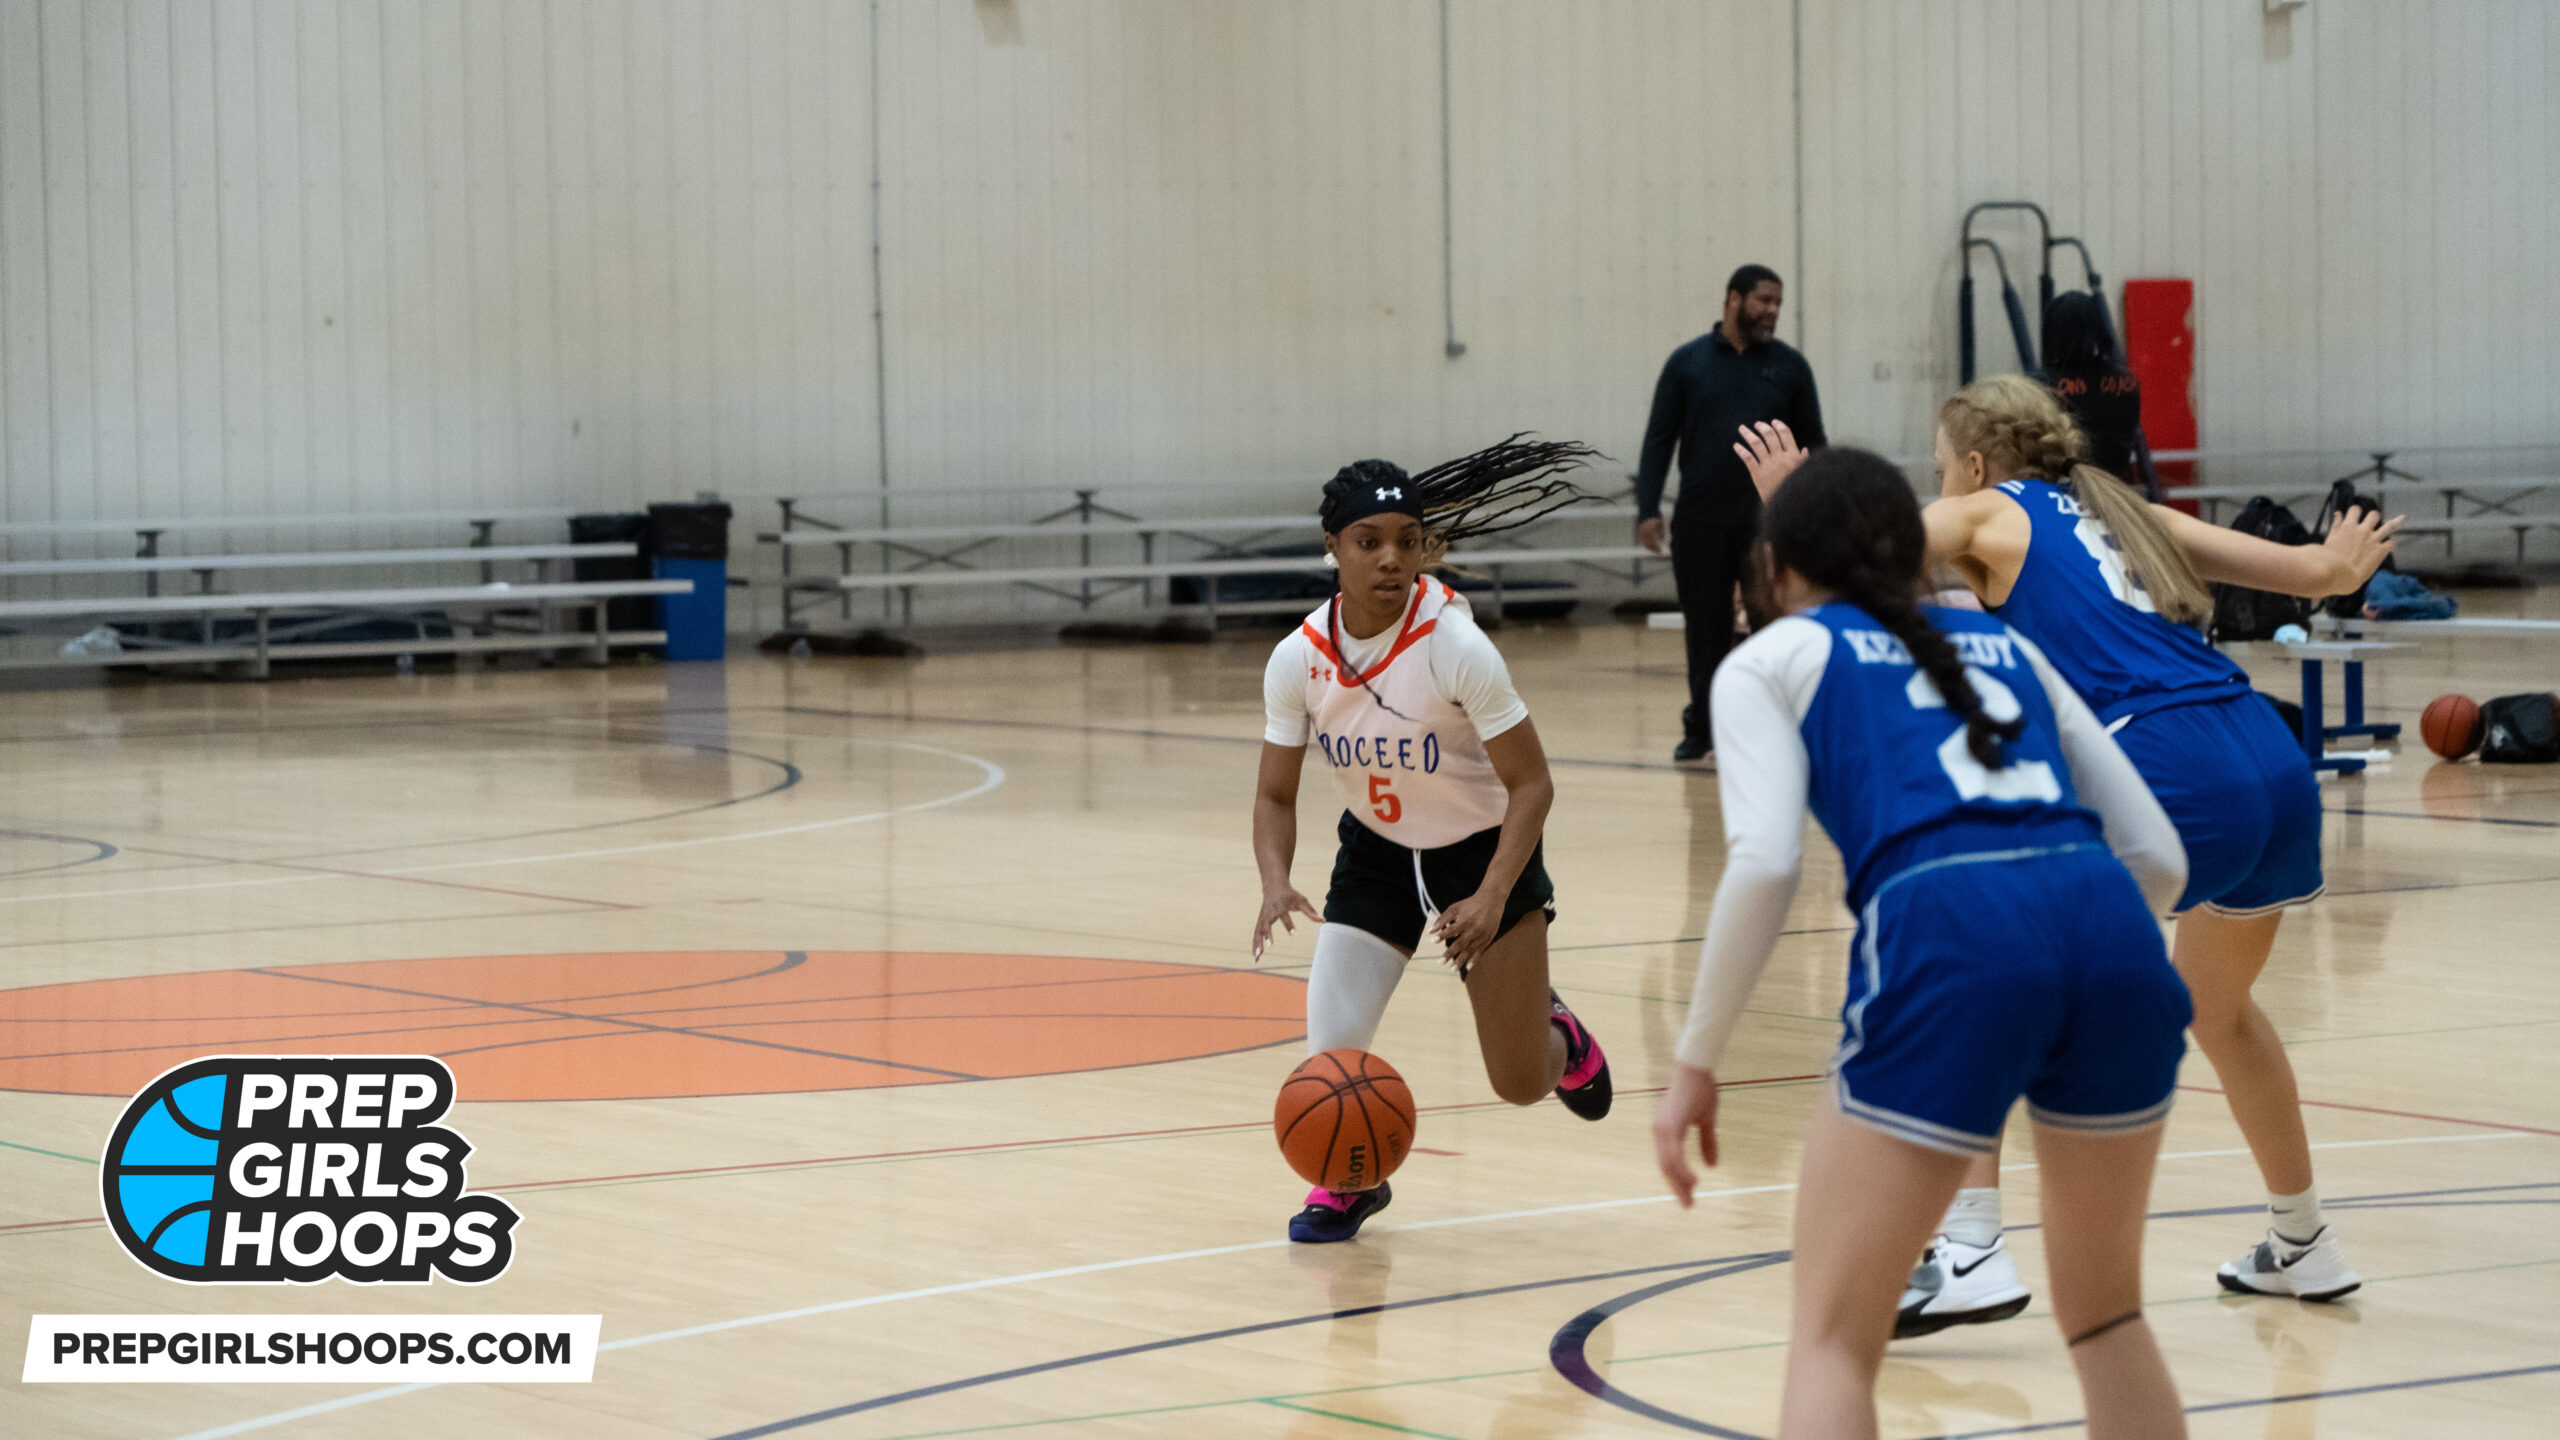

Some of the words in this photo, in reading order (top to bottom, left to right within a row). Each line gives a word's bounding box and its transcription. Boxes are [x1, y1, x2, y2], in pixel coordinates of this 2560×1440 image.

[1315, 731, 1440, 775] ROCEED
[1905, 664, 2063, 804] 2
[1368, 773, 1402, 824] 5
